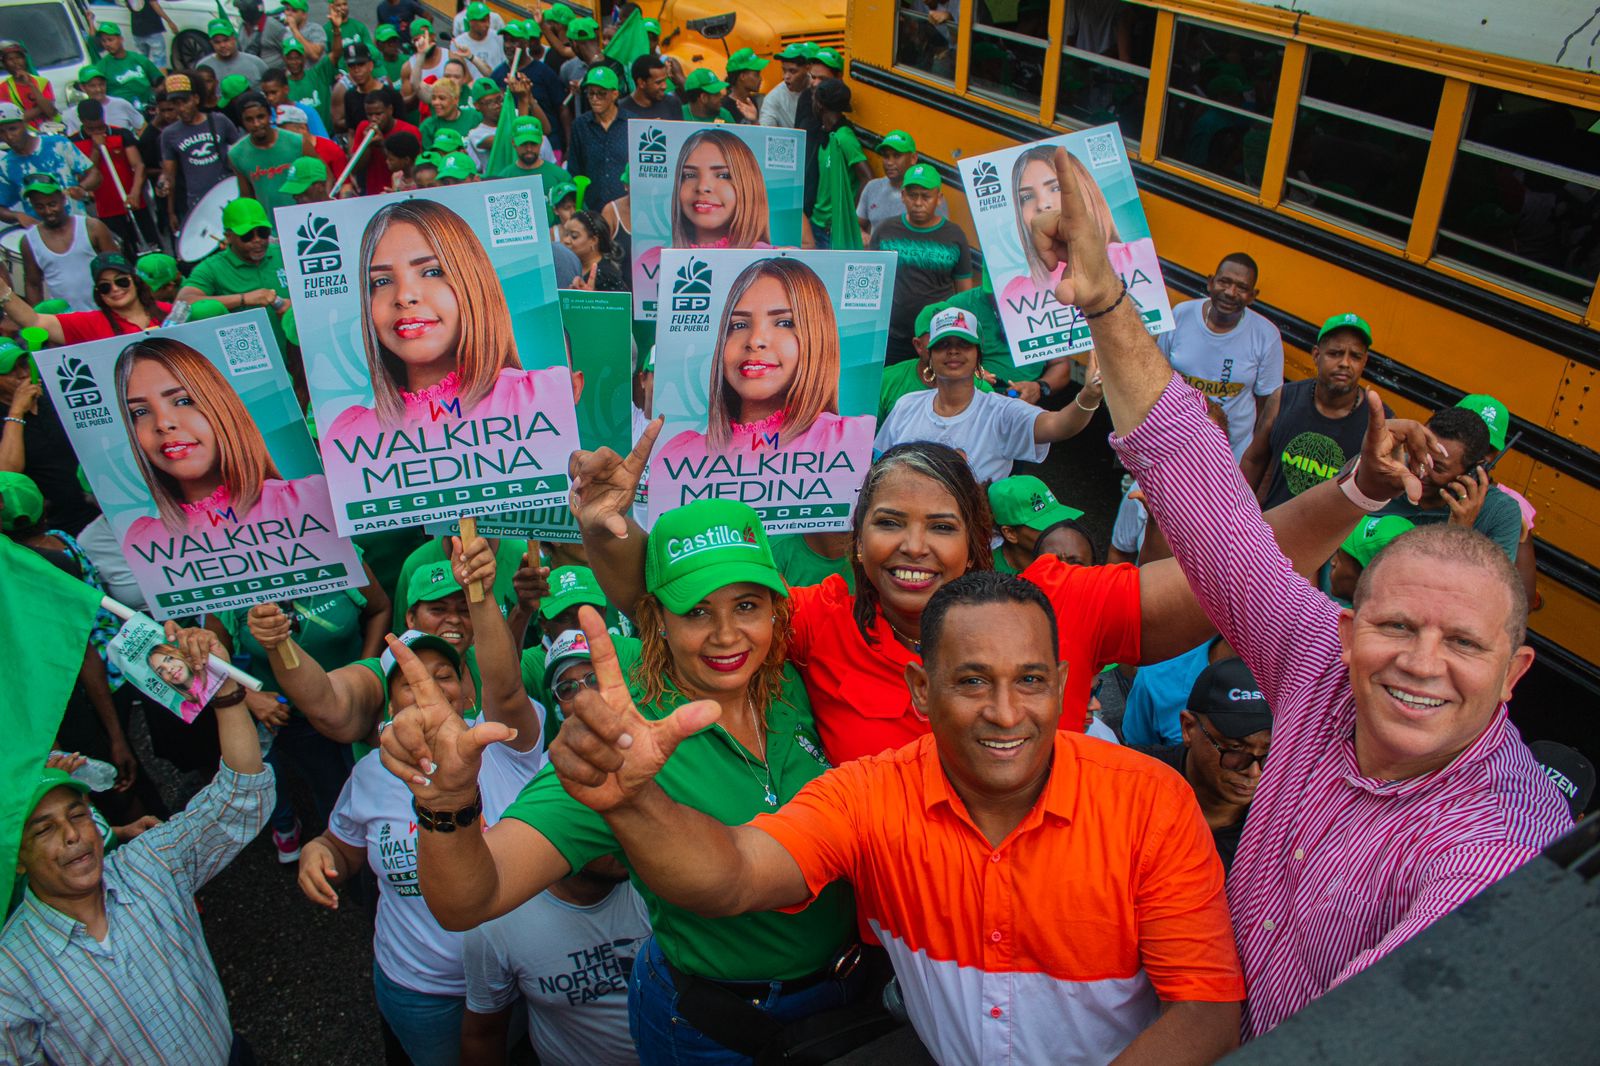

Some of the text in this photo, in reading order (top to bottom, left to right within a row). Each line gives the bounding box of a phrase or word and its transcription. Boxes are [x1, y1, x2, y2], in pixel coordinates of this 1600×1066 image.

[641, 154, 665, 163] FP
[639, 165, 668, 174] FUERZA
[978, 185, 999, 197] FP
[979, 194, 1006, 207] FUERZA
[302, 257, 338, 273] FP
[304, 274, 347, 289] FUERZA
[304, 286, 349, 298] DEL PUEBLO
[675, 298, 707, 309] FP
[671, 314, 710, 324] FUERZA
[669, 324, 709, 332] DEL PUEBLO
[1024, 340, 1093, 361] PARA SEGUIR
[68, 392, 100, 408] FP
[73, 407, 111, 421] FUERZA
[76, 416, 114, 429] DEL PUEBLO
[333, 411, 561, 464] WALKIRIA
[361, 446, 543, 493] MEDINA
[663, 450, 855, 480] WALKIRIA
[362, 480, 550, 514] REGIDORA
[680, 477, 833, 507] MEDINA
[354, 495, 566, 532] PARA SEGUIR SIRVIÉNDOTE!
[477, 527, 530, 536] rabajador
[764, 520, 845, 532] IRVIÉNDOTE!
[131, 513, 330, 564] WALKIRIA
[667, 525, 743, 558] Castillo
[162, 543, 321, 587] MEDINA
[169, 568, 332, 603] REGIDORA
[167, 580, 349, 617] PARA SEGUIR SIRVIÉNDOTE!
[1228, 688, 1265, 701] Cas
[567, 942, 615, 970] THE
[538, 958, 621, 994] NORTH
[566, 974, 626, 1007] FACE
